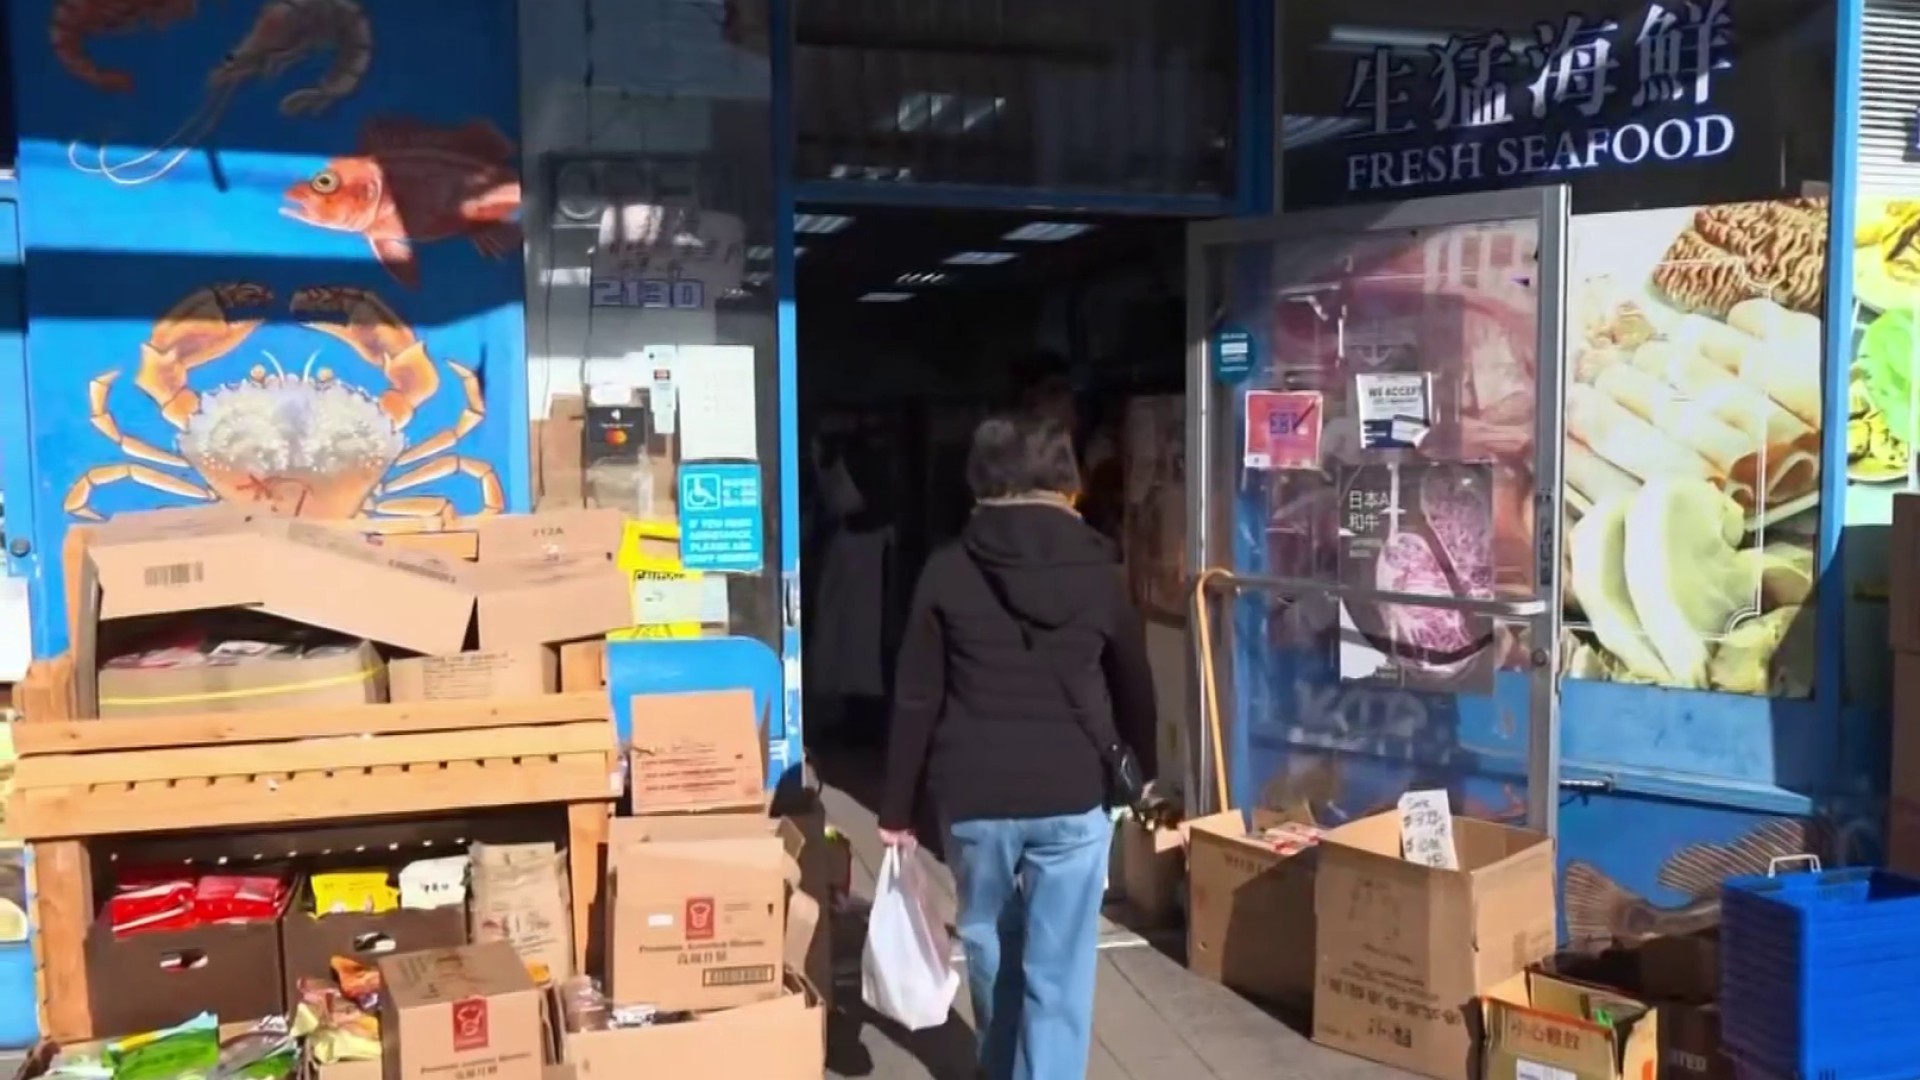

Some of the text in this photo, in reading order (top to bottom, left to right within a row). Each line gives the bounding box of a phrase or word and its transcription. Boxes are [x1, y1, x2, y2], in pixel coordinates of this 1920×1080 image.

[1345, 0, 1733, 138] 生猛海鮮
[1347, 113, 1735, 192] FRESH SEAFOOD
[592, 278, 705, 309] 2130
